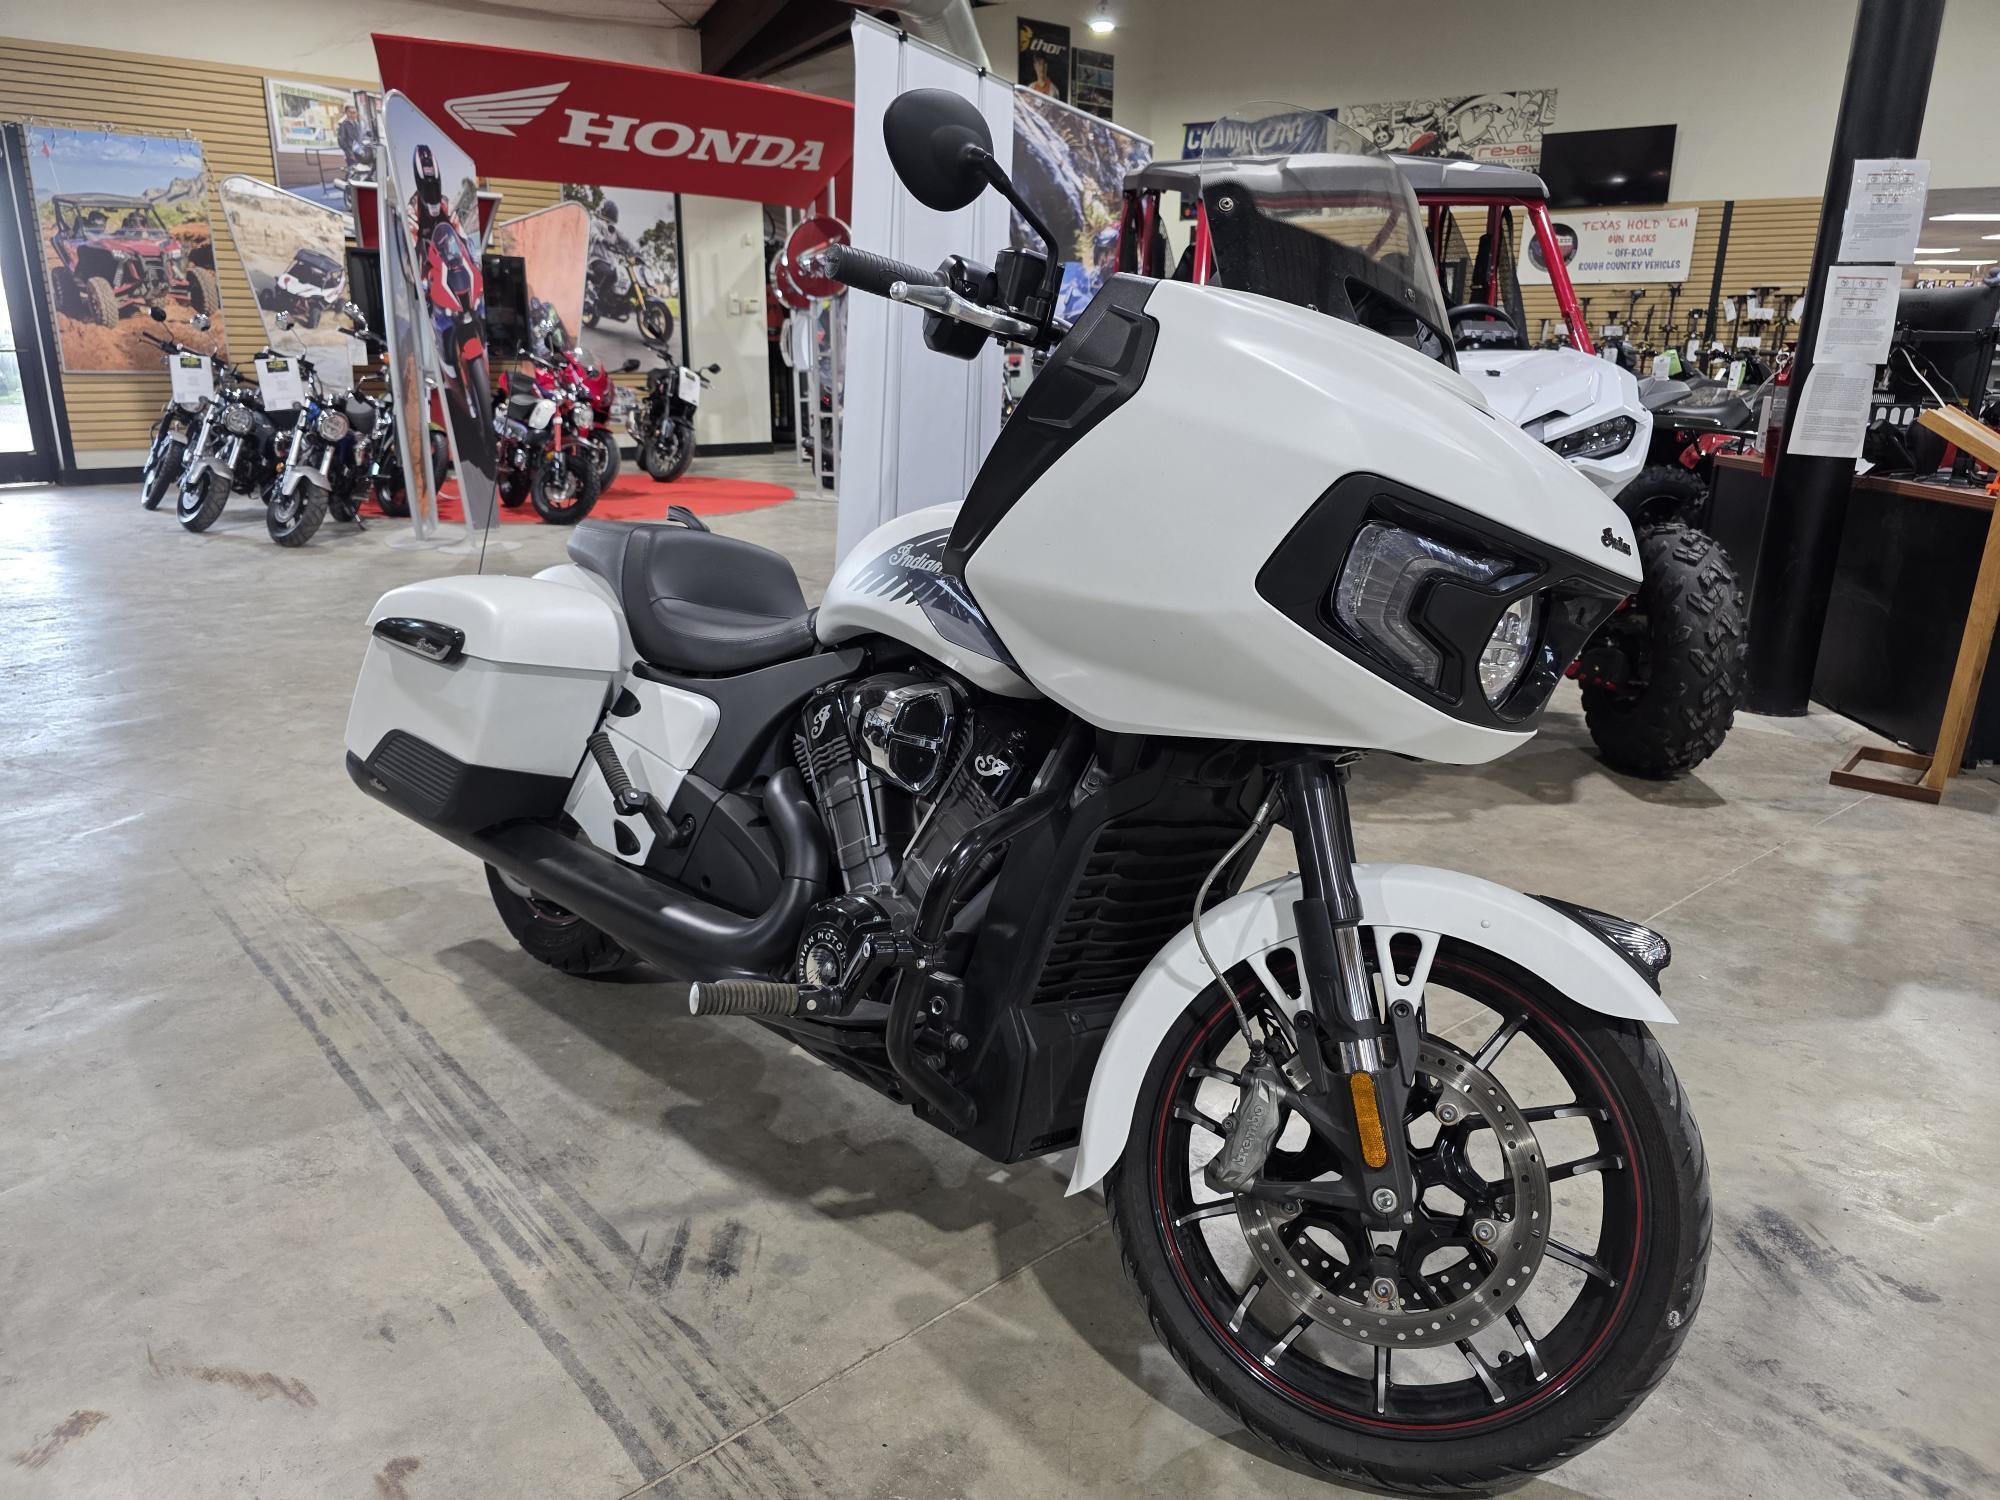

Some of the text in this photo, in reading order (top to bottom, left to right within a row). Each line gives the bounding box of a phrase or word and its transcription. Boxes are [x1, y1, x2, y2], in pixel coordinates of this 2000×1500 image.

[1030, 39, 1066, 55] thor
[558, 108, 825, 172] HONDA
[1582, 220, 1621, 231] TEXAS
[1627, 219, 1660, 230] HOLD
[1608, 233, 1657, 244] GUN RACKS
[1578, 259, 1681, 271] ROUGH COUNTRY VEHICLES
[888, 543, 943, 573] Indian
[799, 935, 815, 984] INDIAN
[1232, 1104, 1264, 1168] brembo
